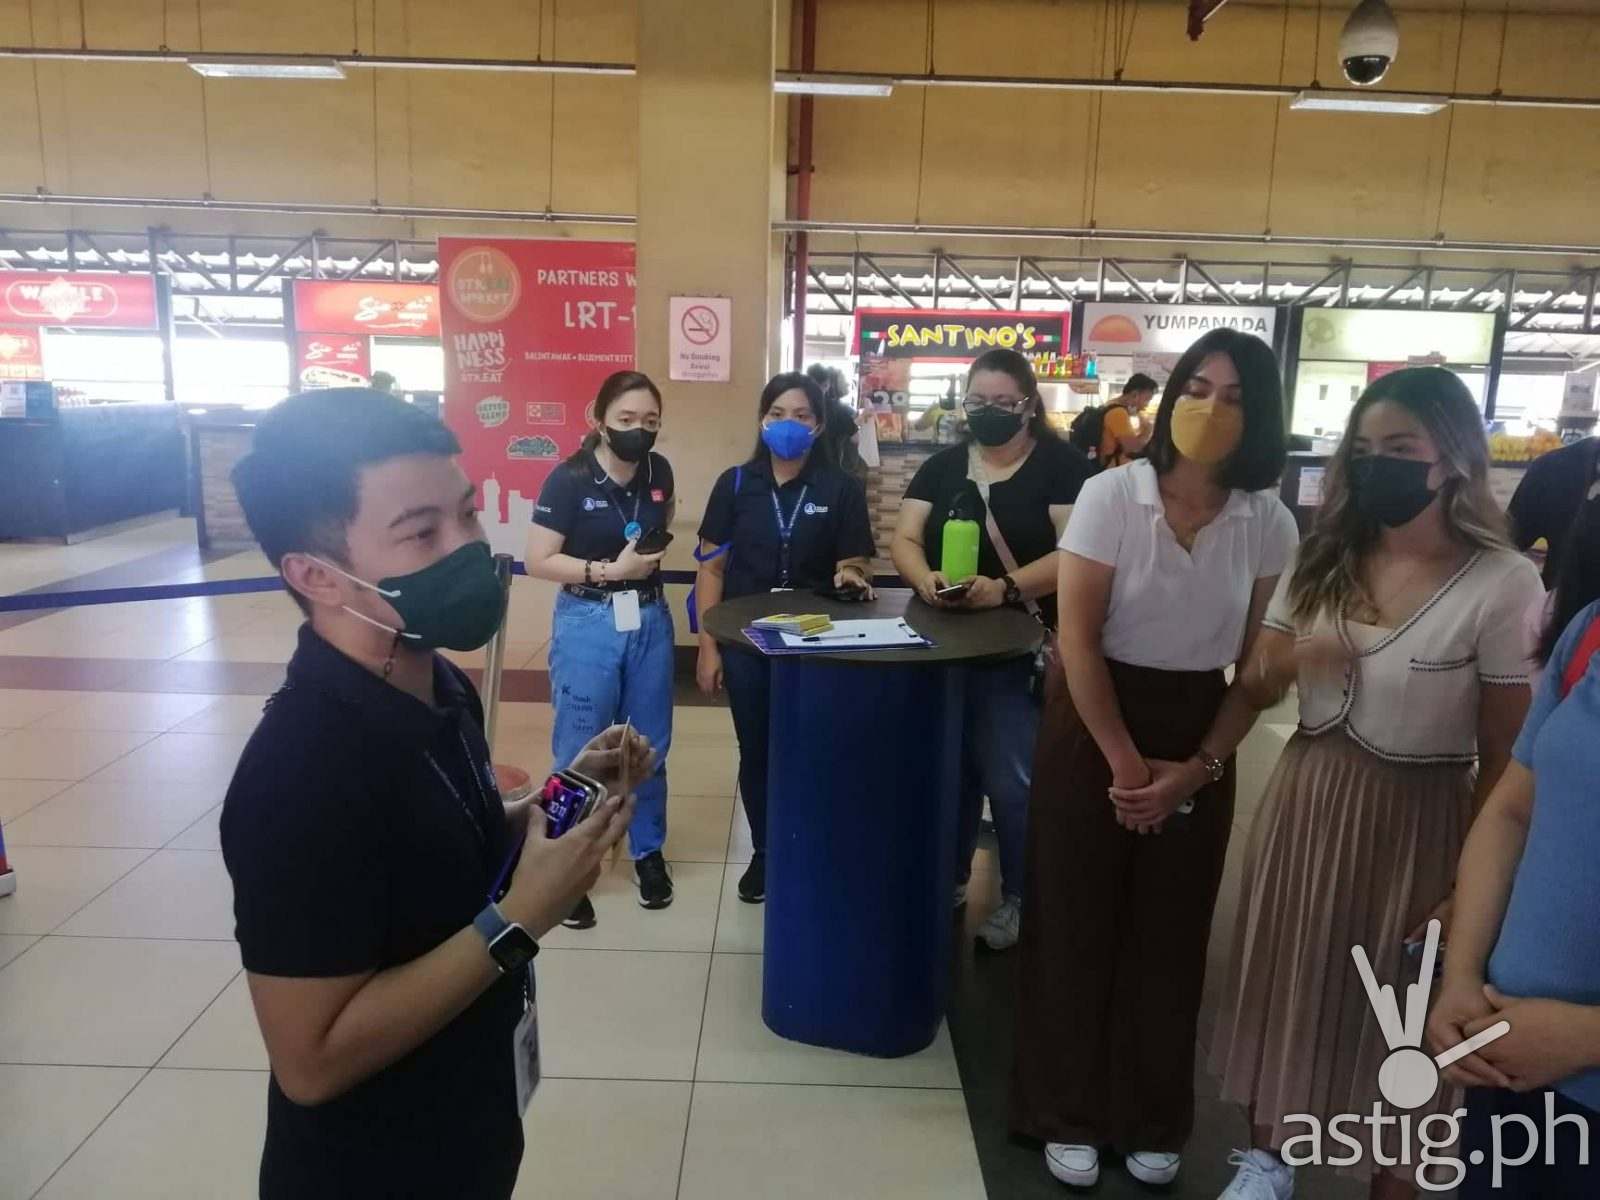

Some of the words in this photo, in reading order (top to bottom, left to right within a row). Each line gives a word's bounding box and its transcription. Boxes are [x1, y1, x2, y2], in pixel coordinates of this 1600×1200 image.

[537, 269, 620, 287] PARTNERS
[1144, 315, 1268, 333] YUMPANADA
[887, 322, 1036, 350] SANTINO'S
[457, 348, 506, 369] NESS
